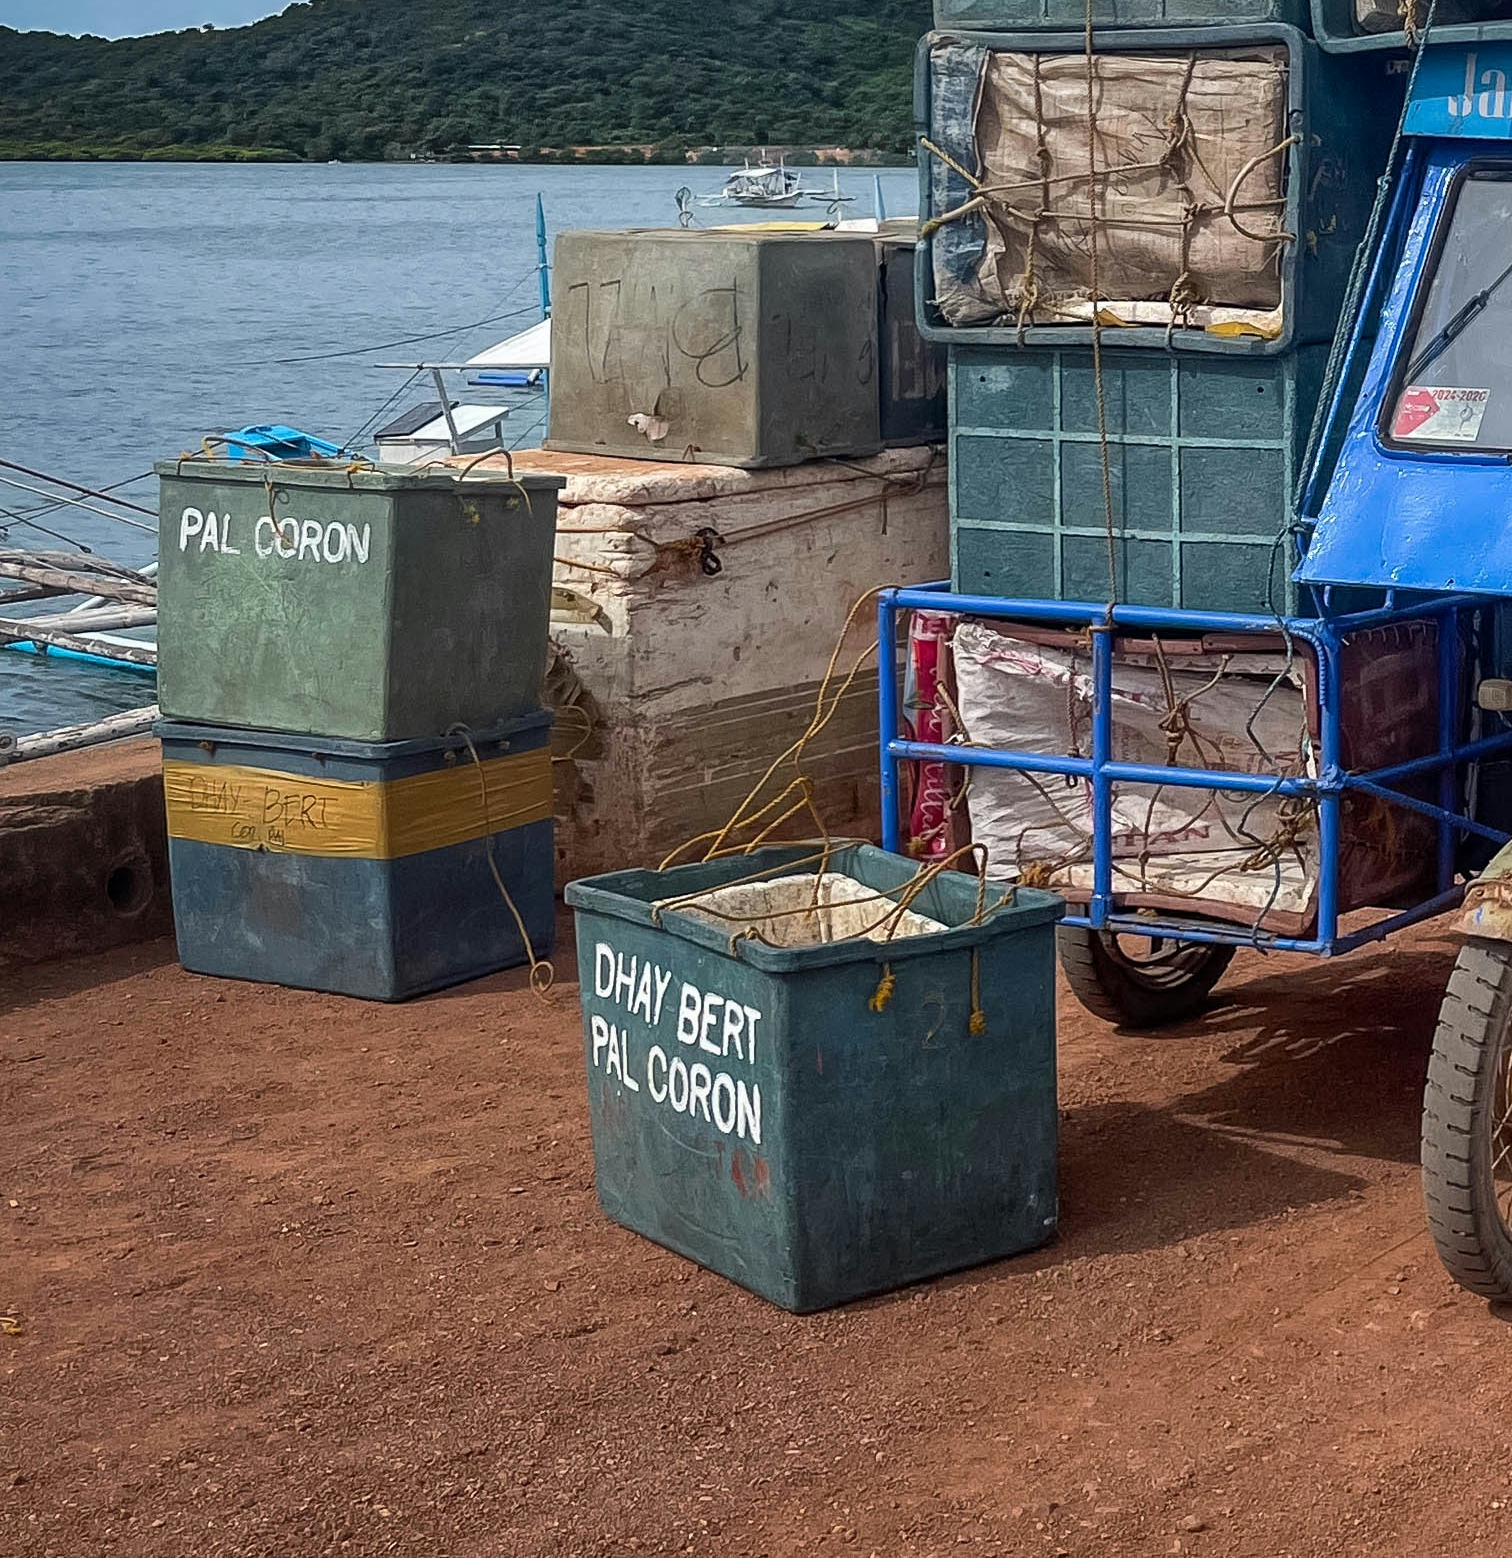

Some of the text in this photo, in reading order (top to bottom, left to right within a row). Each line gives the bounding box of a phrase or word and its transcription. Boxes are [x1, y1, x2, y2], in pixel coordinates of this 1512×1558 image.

[179, 506, 371, 564] PAL CORON
[262, 785, 339, 831] BERT
[594, 941, 763, 1066] DHAY BERT
[591, 1014, 763, 1145] PAL CORON
